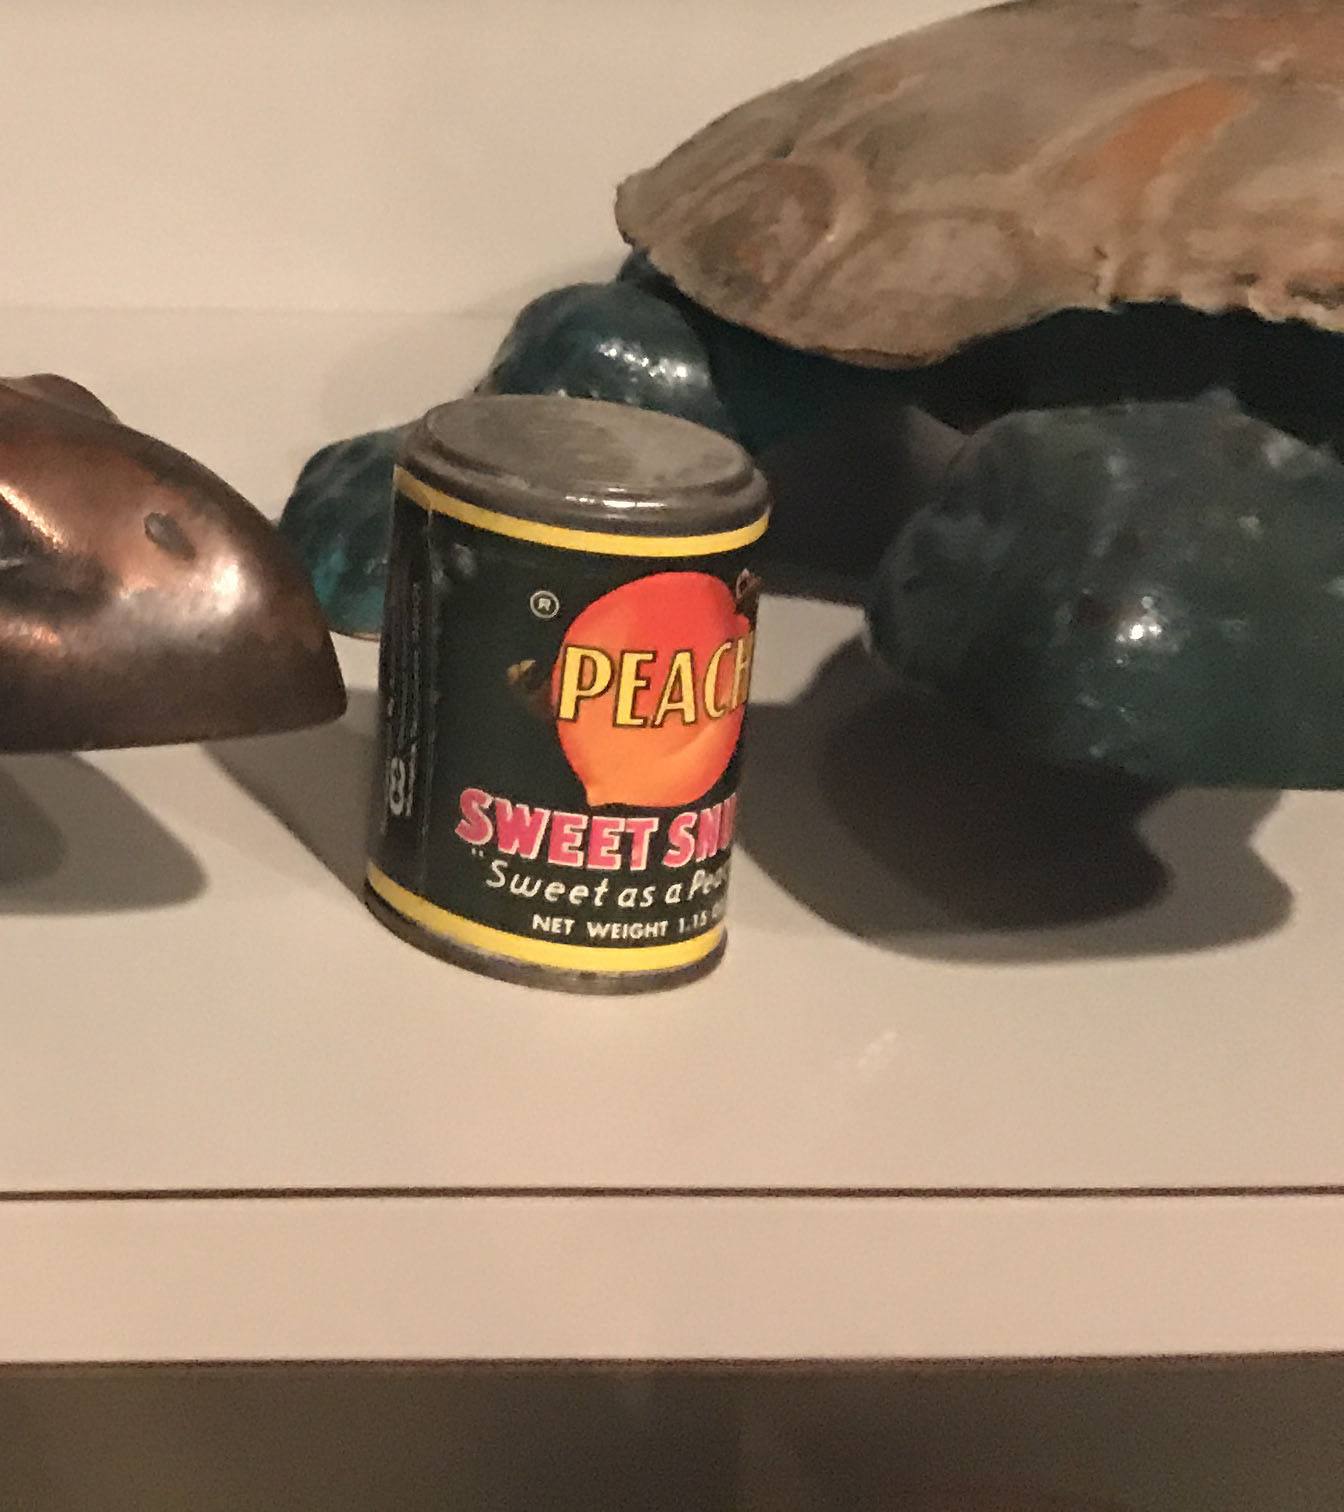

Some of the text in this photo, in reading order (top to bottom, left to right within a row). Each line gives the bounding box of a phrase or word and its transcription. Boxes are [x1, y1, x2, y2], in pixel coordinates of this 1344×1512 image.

[557, 631, 755, 729] PEACH
[454, 787, 660, 871] SWEET
[618, 885, 655, 908] as
[665, 882, 682, 905] a
[532, 914, 575, 936] NET
[587, 920, 668, 940] WEIGHT
